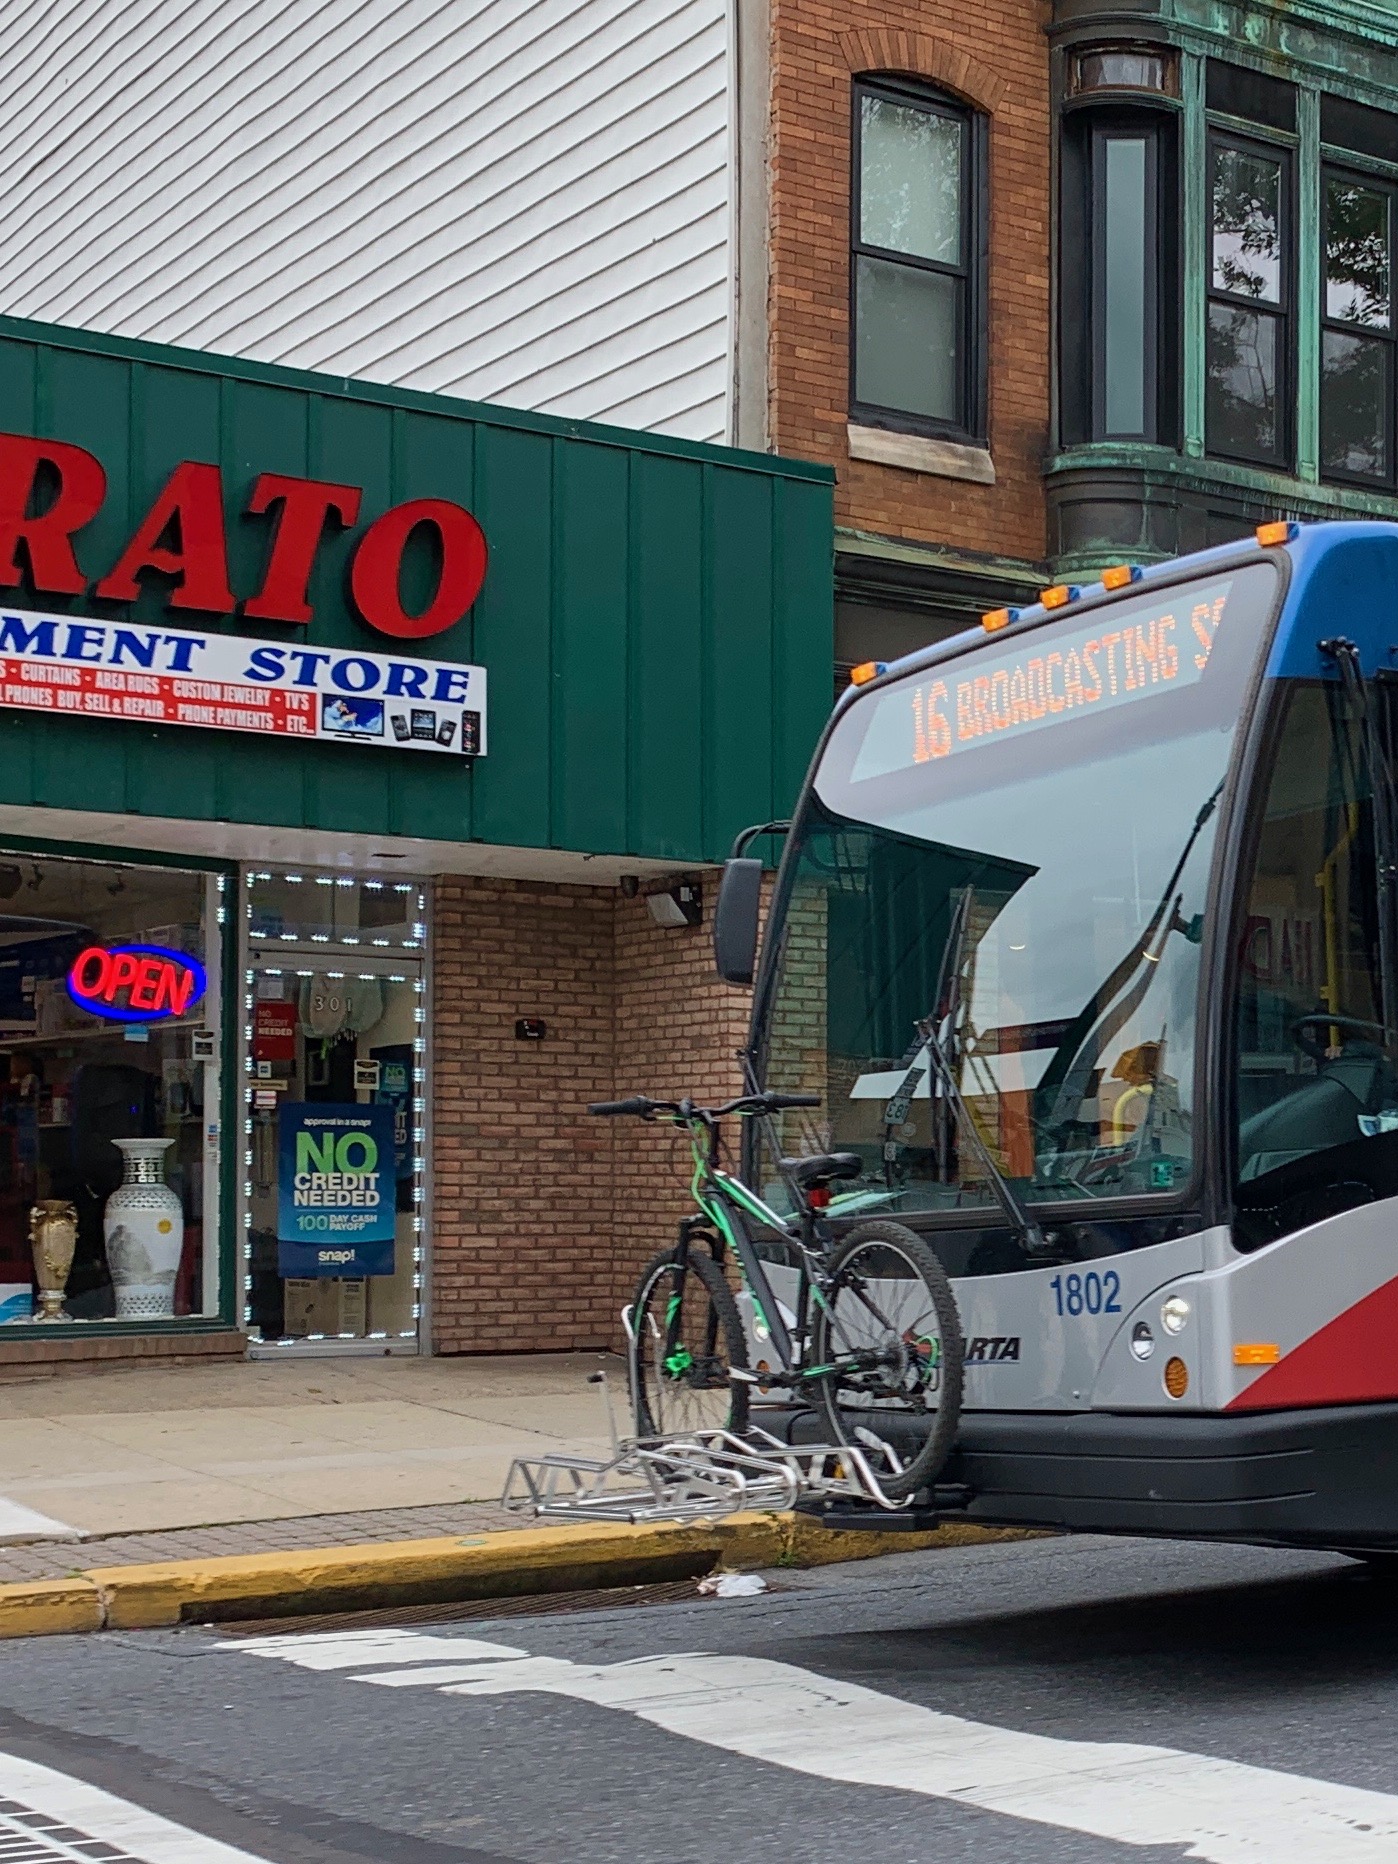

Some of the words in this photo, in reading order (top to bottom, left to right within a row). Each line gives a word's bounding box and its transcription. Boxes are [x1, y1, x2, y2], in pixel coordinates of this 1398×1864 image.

[0, 433, 488, 639] RATO
[20, 662, 82, 687] CURTAINS
[95, 671, 126, 691] AREA
[127, 675, 160, 695] RUGS
[172, 679, 221, 701] CUSTOM
[223, 687, 271, 707] JEWELRY
[243, 647, 469, 704] STORE
[912, 680, 952, 763] 16
[956, 614, 1179, 741] BROADCASTING
[1191, 597, 1226, 669] S
[5, 684, 53, 706] PHONES
[84, 692, 110, 712] SELL
[123, 696, 165, 718] REPAIR
[176, 703, 216, 725] PHONE
[216, 709, 274, 730] PAYMENTS
[71, 947, 193, 1016] OPEN
[315, 996, 352, 1012] 301
[296, 1131, 378, 1174] NO
[294, 1172, 380, 1190] CREDIT
[294, 1190, 380, 1206] NEEDED
[297, 1215, 328, 1231] 100
[329, 1215, 349, 1223] DAY
[350, 1215, 377, 1223] CASH
[329, 1223, 366, 1231] PAYOFF
[318, 1249, 355, 1264] snap!
[1050, 1270, 1122, 1316] 1802
[962, 1337, 1020, 1361] RTA
